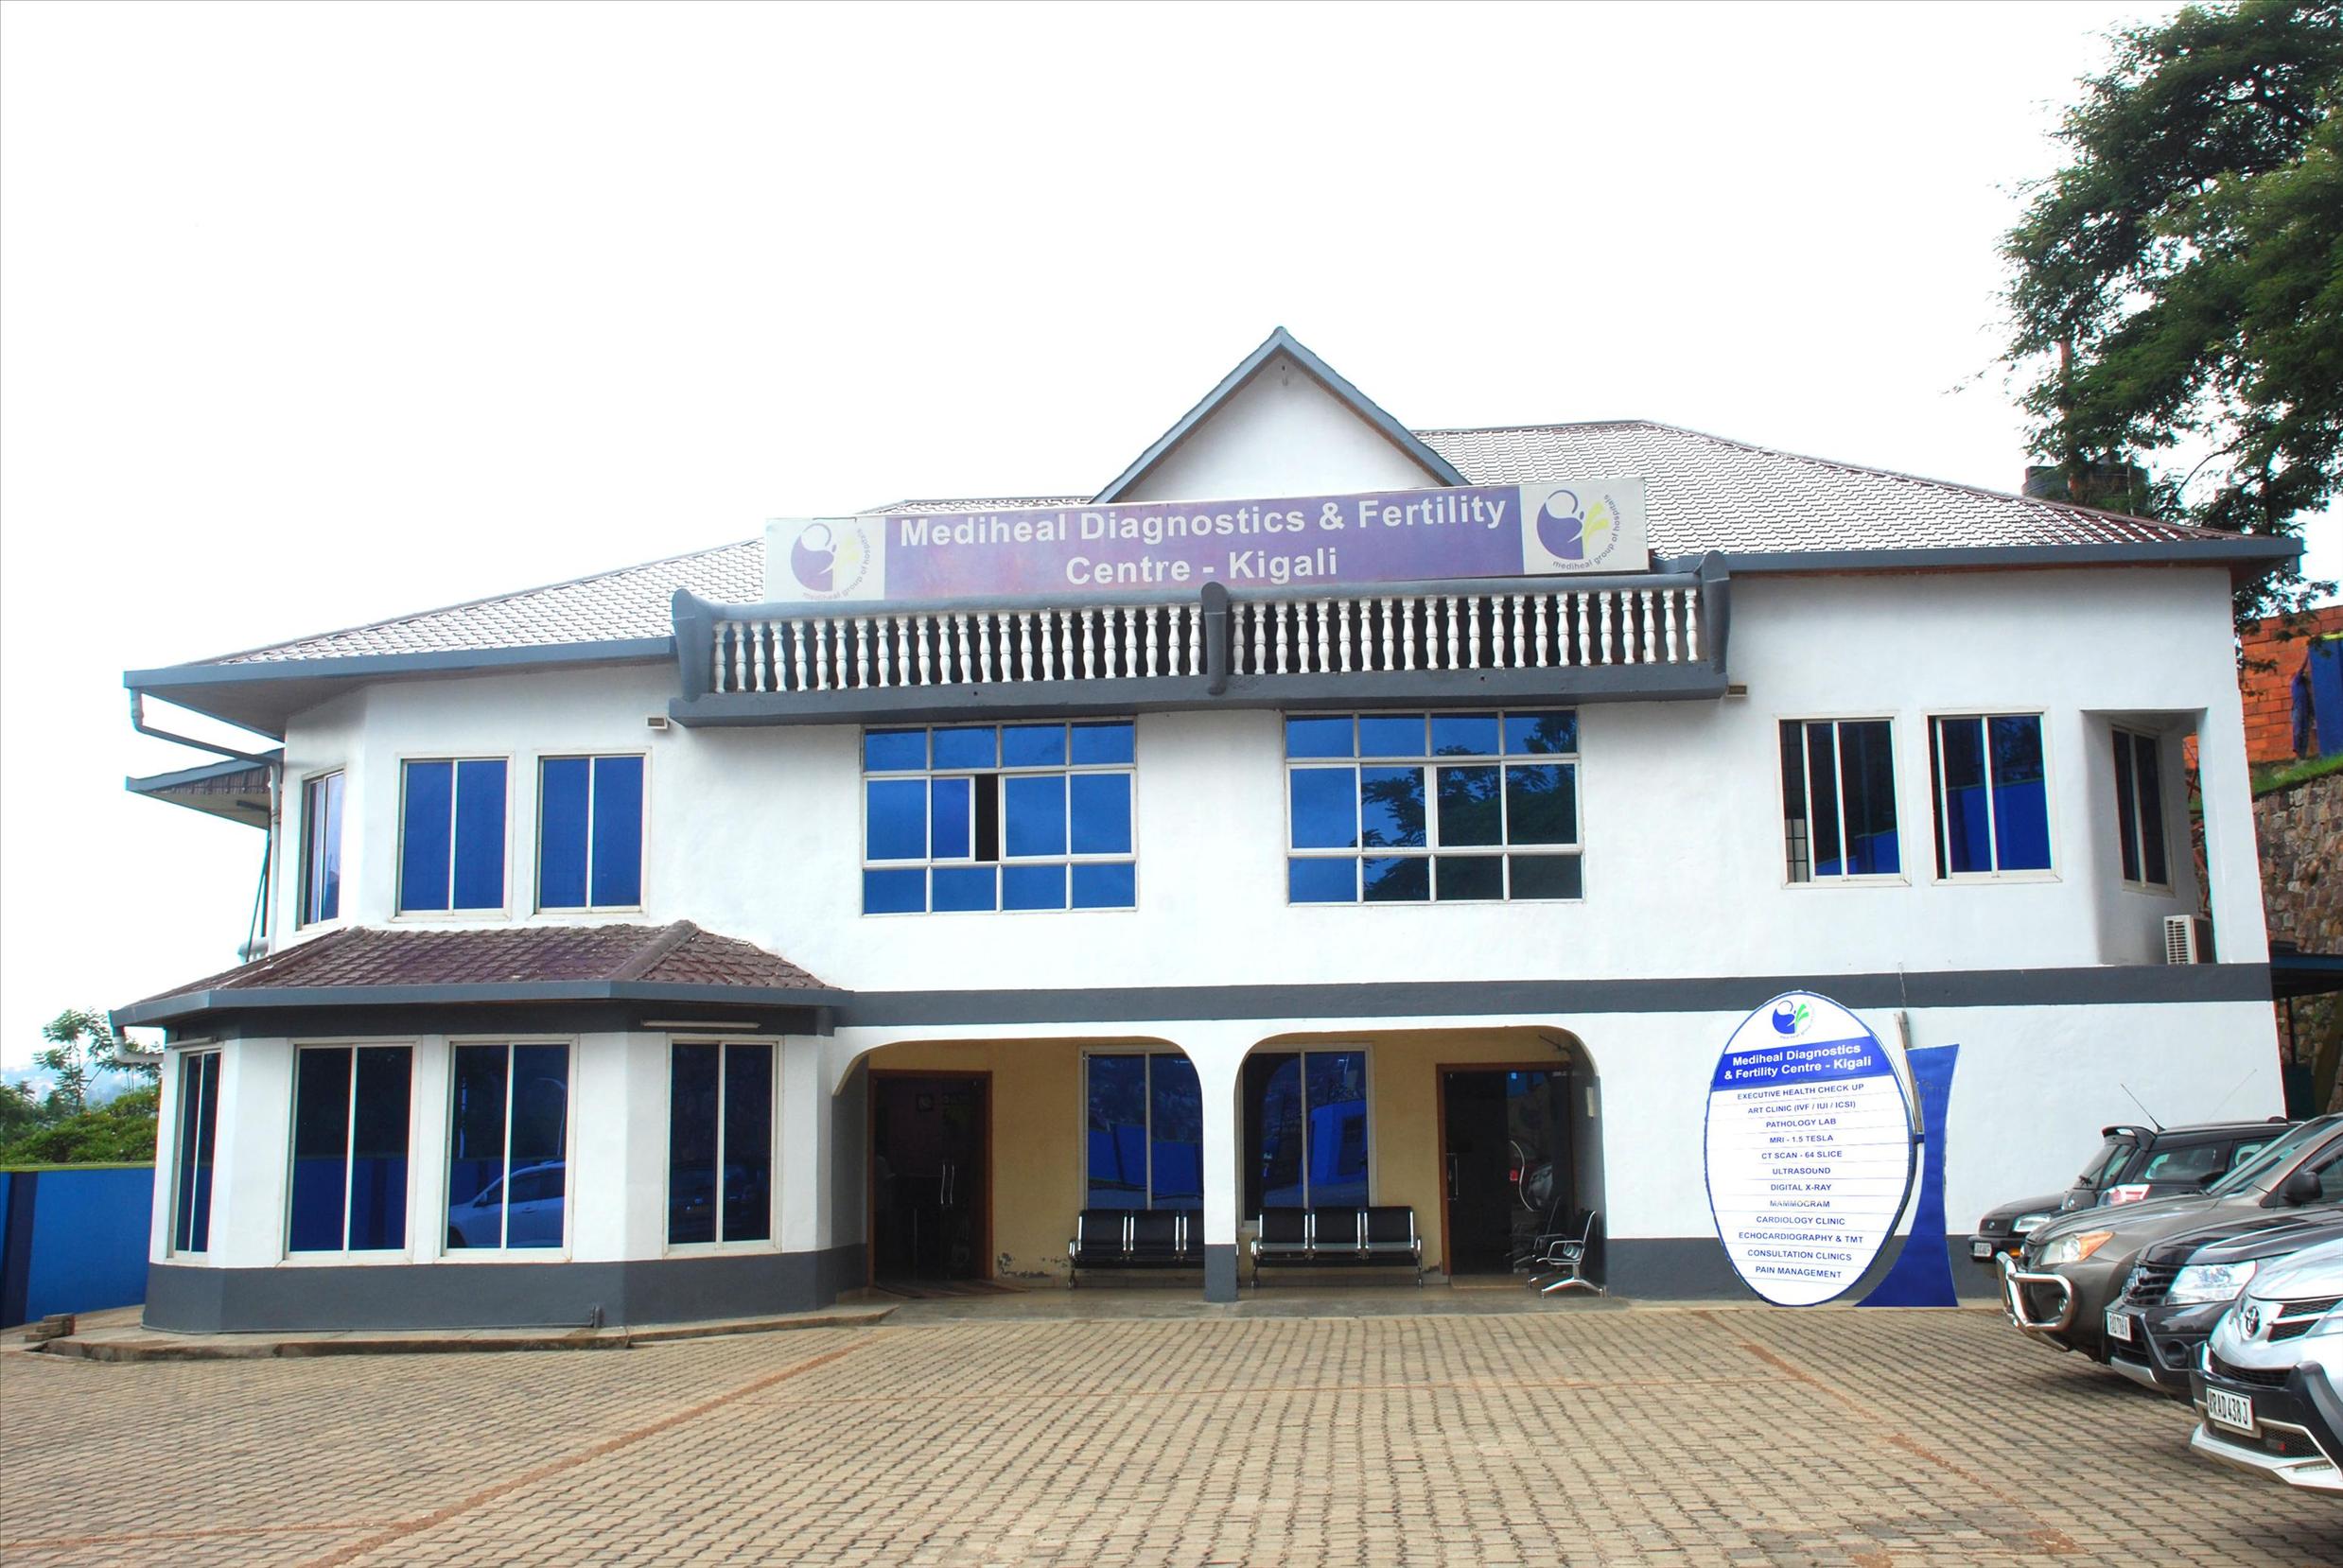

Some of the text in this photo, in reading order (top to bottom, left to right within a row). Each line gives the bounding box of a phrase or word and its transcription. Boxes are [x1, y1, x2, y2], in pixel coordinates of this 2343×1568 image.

[900, 497, 1507, 547] Mediheal Diagnostics & Fertility
[1552, 494, 1620, 570] mediheal group of hospitals
[1066, 556, 1191, 585] Centre
[1229, 548, 1338, 584] Kigali
[1732, 1044, 1862, 1067] Mediheal Diagnostics
[1724, 1071, 1733, 1080] &
[1736, 1066, 1778, 1079] Fertility
[1781, 1062, 1822, 1074] Centre
[1833, 1055, 1872, 1071] Kigali
[1737, 1083, 1864, 1100] EXECUTIVE HEALTH CHECK UP
[1765, 1105, 1792, 1113] CLINIC
[1793, 1103, 1810, 1112] (IVF
[1816, 1102, 1828, 1110] IUI
[1835, 1100, 1856, 1109] ICSI)
[1765, 1119, 1816, 1128] PATHOLOGY
[1806, 1134, 1834, 1142] TESLA
[1816, 1150, 1843, 1159] SLICE
[1756, 1215, 1845, 1226] CARDIOLOGY CLINIC
[1739, 1231, 1833, 1243] ECHOCARDIOGRAPHY
[1845, 1235, 1863, 1244] TMT
[1747, 1249, 1852, 1261] CONSULTATION CLINICS
[1755, 1265, 1842, 1279] PAIN MANAGEMENT
